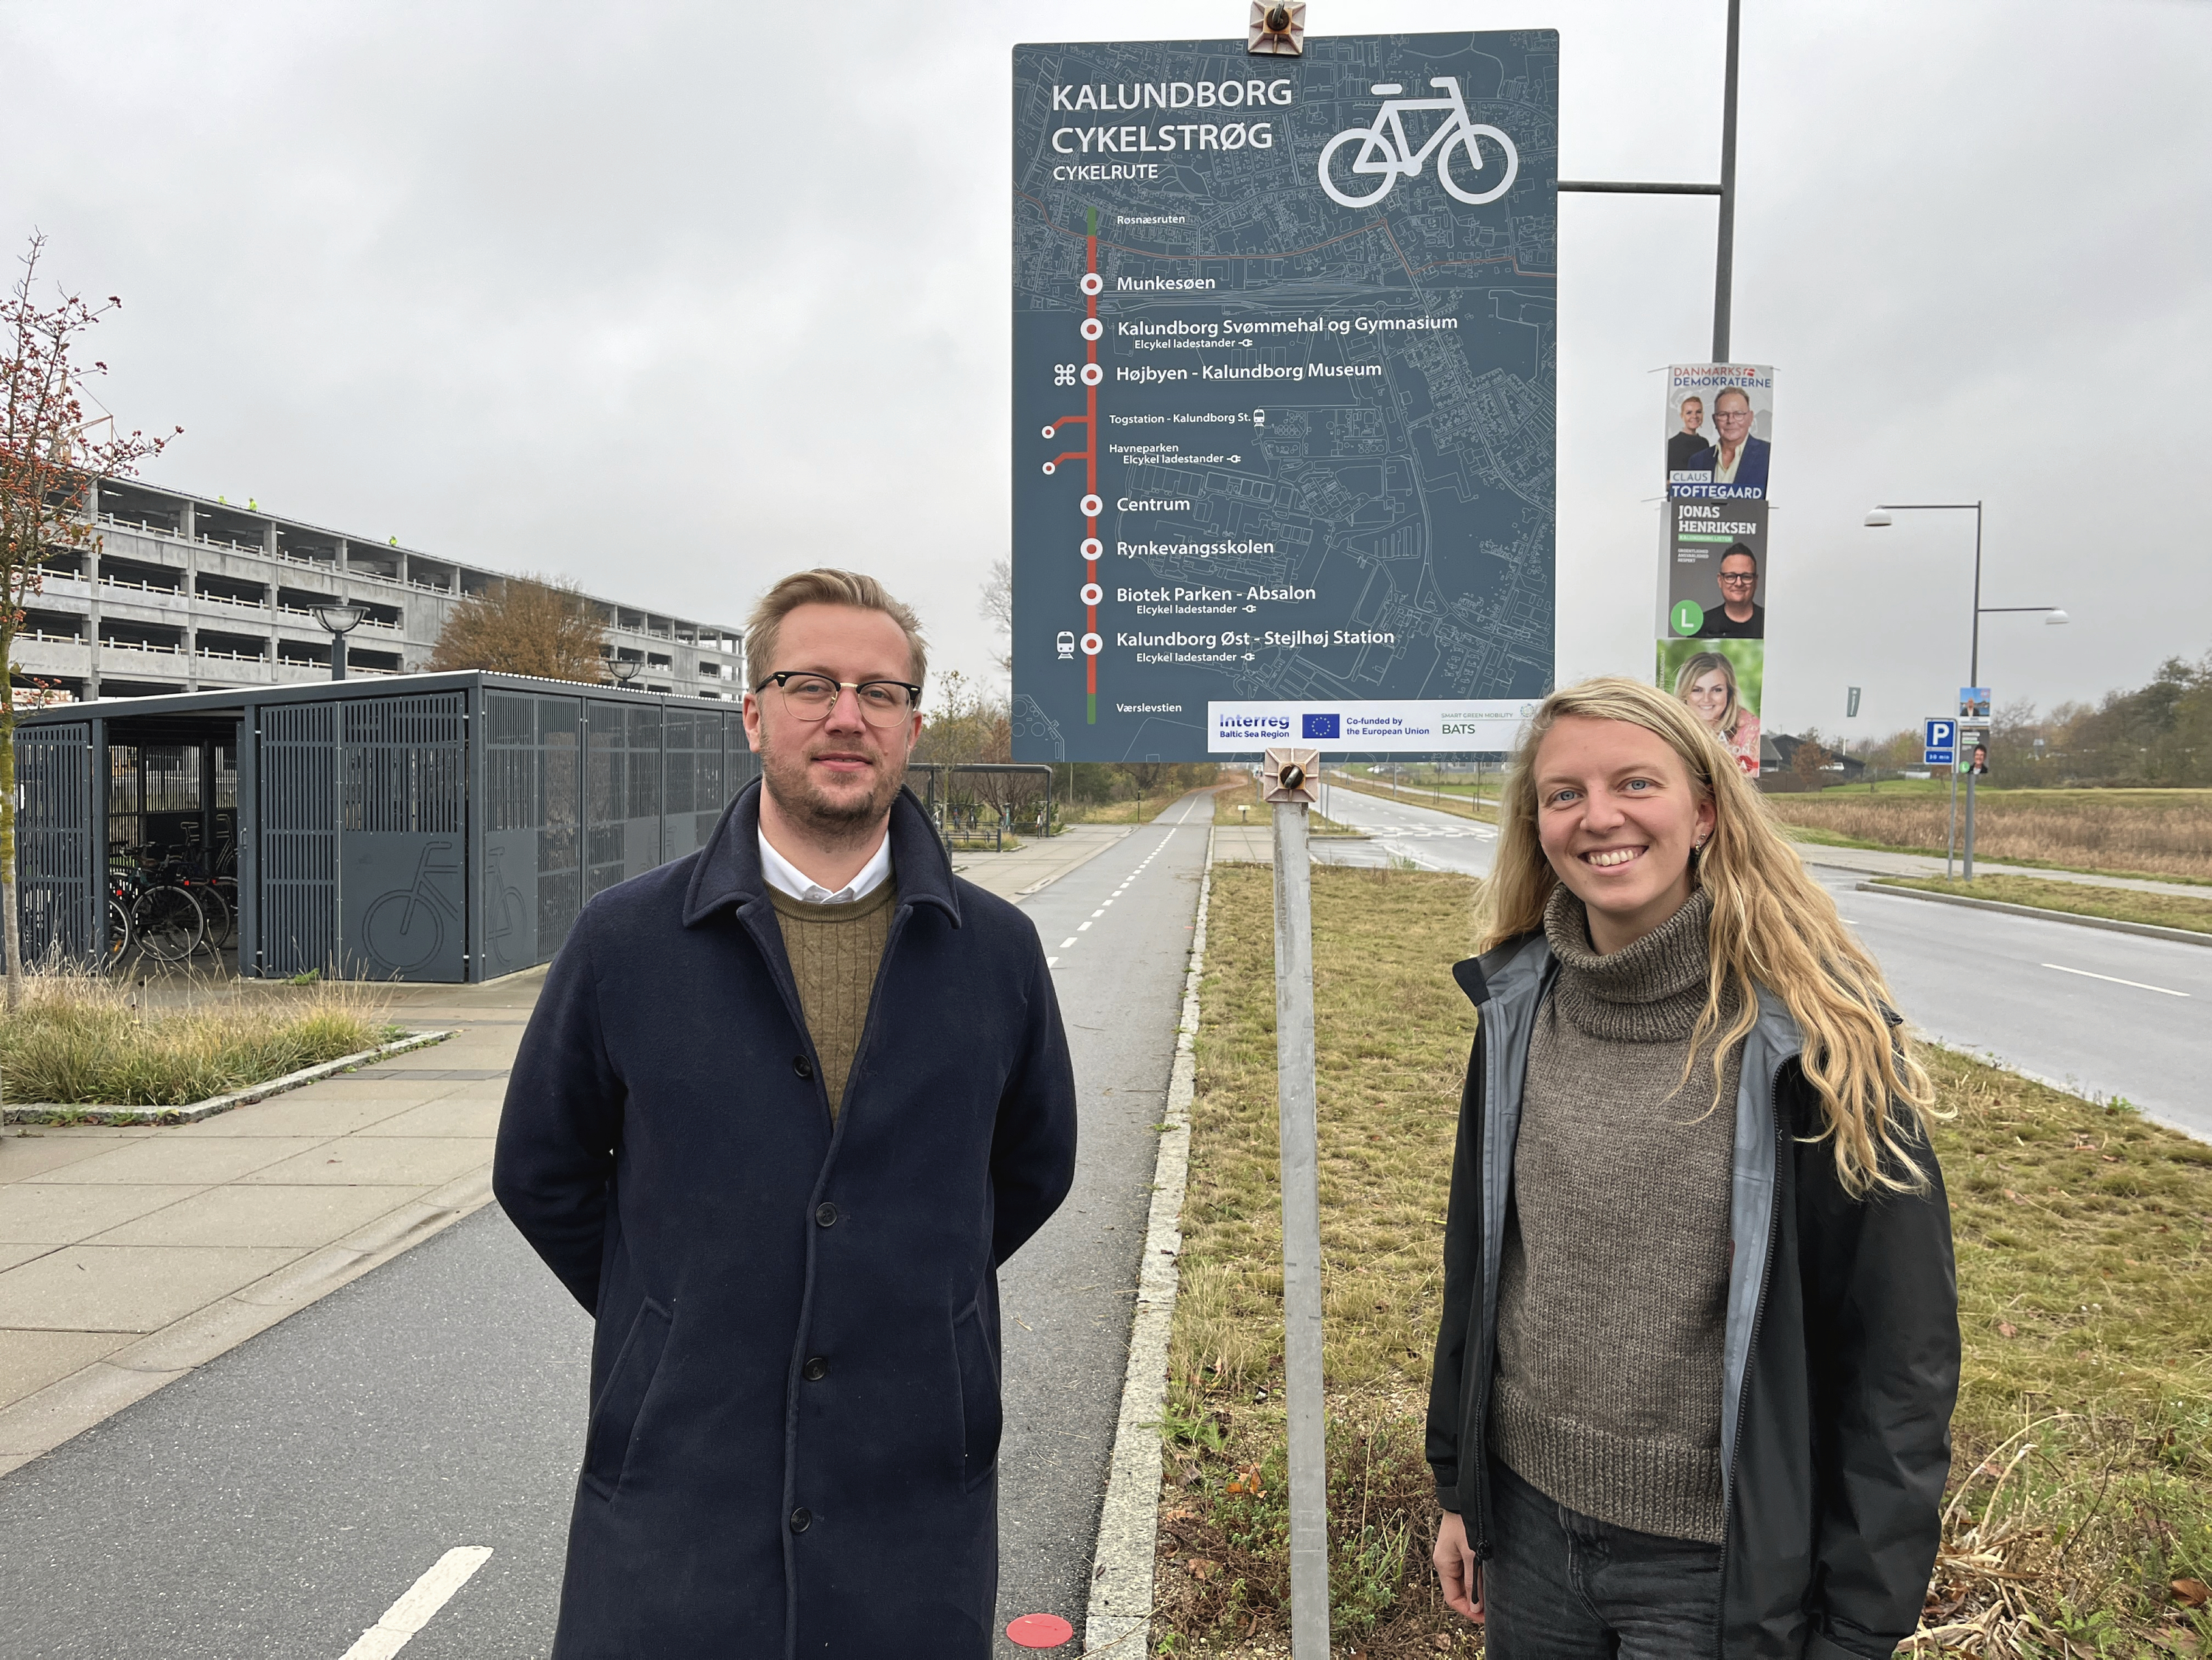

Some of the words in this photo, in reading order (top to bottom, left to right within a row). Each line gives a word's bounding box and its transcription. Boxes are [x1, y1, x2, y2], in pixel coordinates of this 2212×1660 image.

[1054, 80, 1291, 110] KALUNDBORG
[1052, 122, 1271, 153] CYKELSTRØG
[1054, 164, 1158, 180] CYKELRUTE
[1118, 215, 1185, 224] Røsnæsruten
[1118, 276, 1214, 290] Munkesøen
[1119, 321, 1217, 337] Kalundborg
[1223, 317, 1323, 333] Svømmehal
[1328, 321, 1349, 334] og
[1355, 315, 1457, 334] Gymnasium
[1135, 339, 1170, 350] Elcykel
[1174, 338, 1235, 347] ladestander
[1117, 366, 1186, 383] Højbyen
[1203, 364, 1303, 381] Kalundborg
[1309, 364, 1381, 377] Museum
[1674, 367, 1742, 377] DANMARKS
[1674, 377, 1771, 388] DEMOKRATERNE
[1110, 415, 1164, 426] Togstation
[1174, 413, 1234, 423] Kalundborg
[1238, 412, 1251, 422] St.
[1110, 443, 1178, 454] Havneparken
[1124, 454, 1158, 465] Elcykel
[1162, 454, 1223, 463] ladestander
[1673, 473, 1708, 482] CLAUS
[1672, 485, 1762, 499] TOFTEGAARD
[1117, 498, 1189, 511] Centrum
[1678, 505, 1720, 518] JONAS
[1678, 521, 1756, 535] HENRIKSEN
[1118, 540, 1273, 558] Rynkevangsskolen
[1118, 587, 1170, 601] Biotek
[1175, 587, 1231, 601] Parken
[1247, 586, 1315, 600] Absalon
[1137, 605, 1172, 616] Elcykel
[1176, 604, 1237, 613] ladestander
[1682, 608, 1694, 628] L
[1118, 632, 1216, 649] Kalundborg
[1221, 631, 1250, 645] Øst
[1265, 631, 1328, 647] Stejlhøj
[1334, 630, 1394, 644] Station
[1137, 653, 1172, 664] Elcykel
[1175, 653, 1237, 661] ladestander
[1116, 704, 1181, 712] Værslevstien
[1220, 714, 1290, 730] Interreg
[1346, 717, 1390, 725] Co-funded
[1392, 718, 1402, 726] by
[1261, 730, 1290, 740] Region
[1362, 727, 1404, 737] European
[1442, 723, 1475, 735] BATS
[1933, 723, 1950, 746] P
